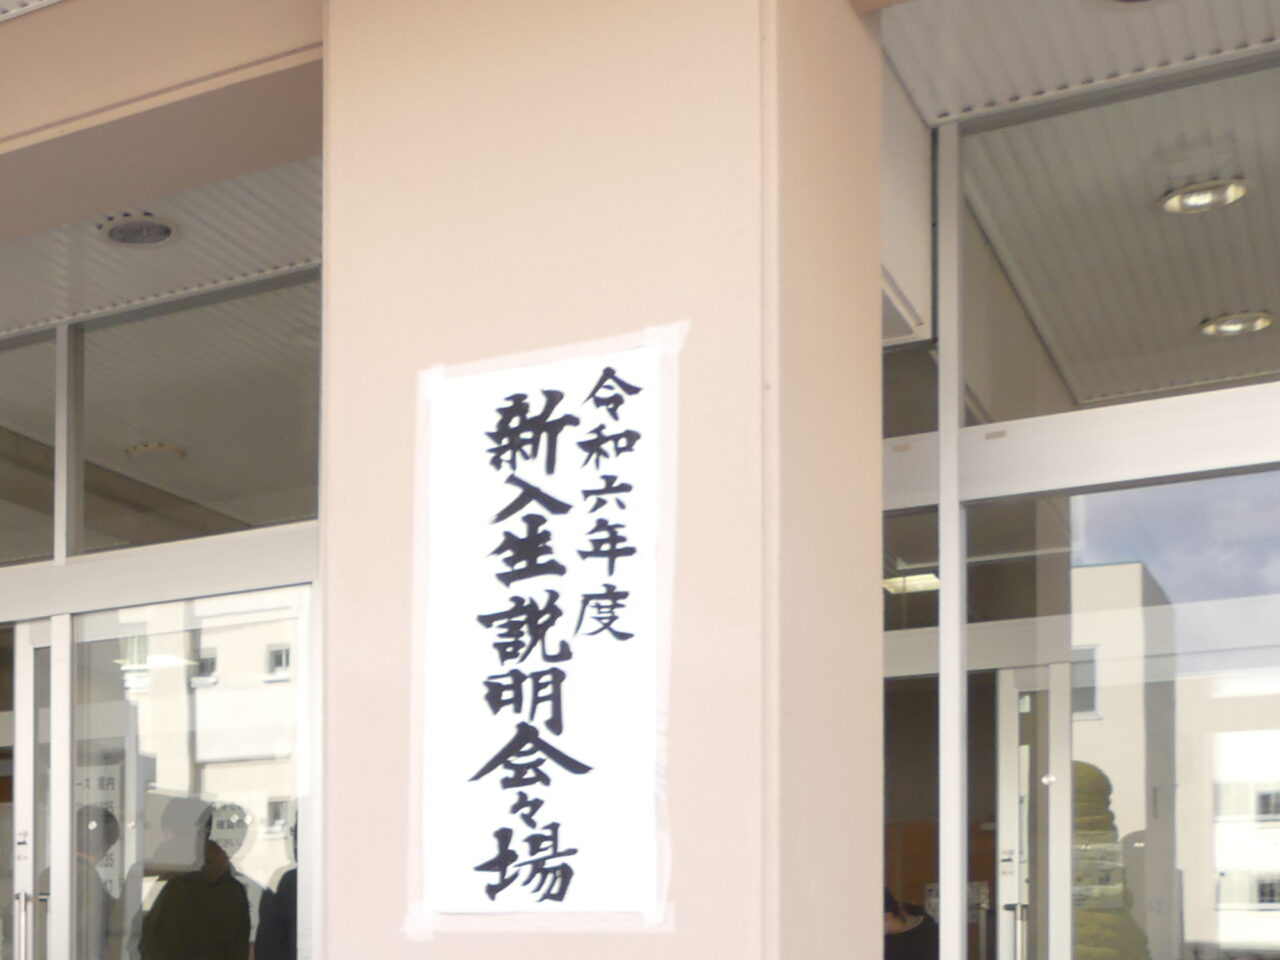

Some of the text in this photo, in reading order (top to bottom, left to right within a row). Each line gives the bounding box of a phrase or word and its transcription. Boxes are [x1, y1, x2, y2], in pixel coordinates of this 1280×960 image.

[468, 388, 594, 903] 新入生説明会々場
[575, 366, 643, 642] 令和六年度
